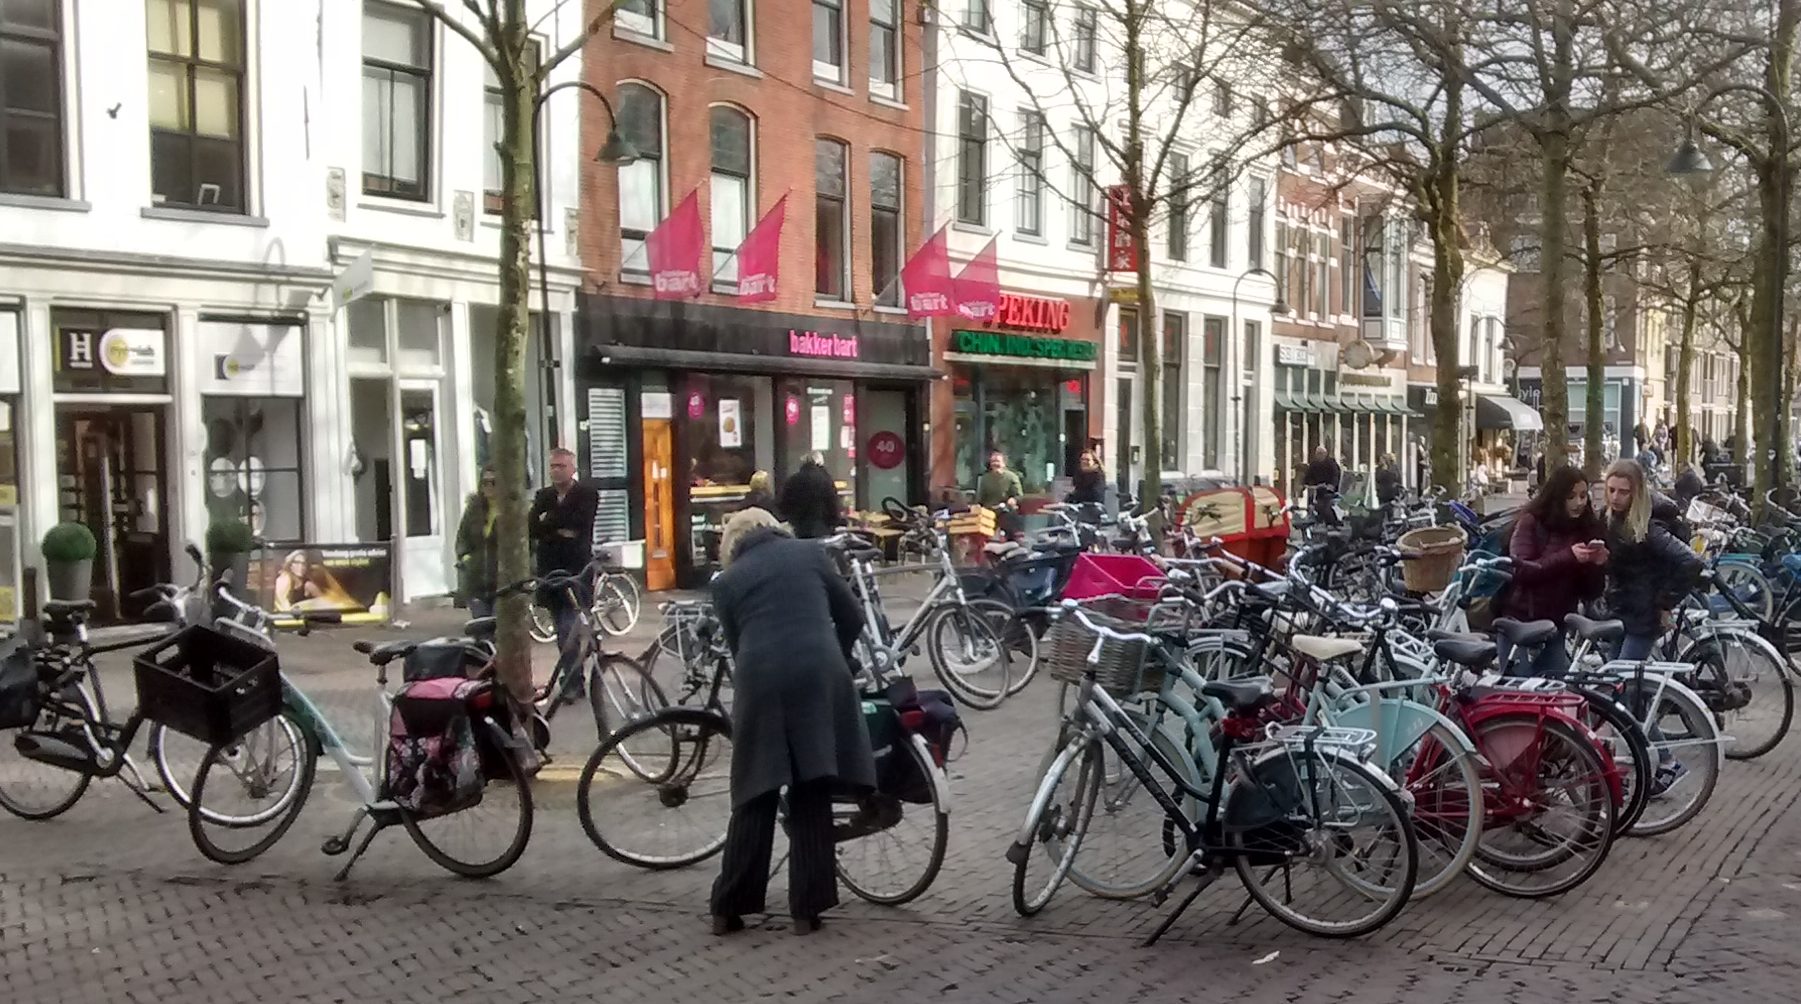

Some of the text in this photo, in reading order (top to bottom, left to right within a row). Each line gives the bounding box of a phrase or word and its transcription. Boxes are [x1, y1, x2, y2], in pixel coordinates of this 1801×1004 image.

[655, 272, 697, 292] bart
[740, 275, 776, 296] bart
[910, 294, 949, 311] bart
[992, 294, 1072, 331] PEKING
[69, 333, 92, 361] H
